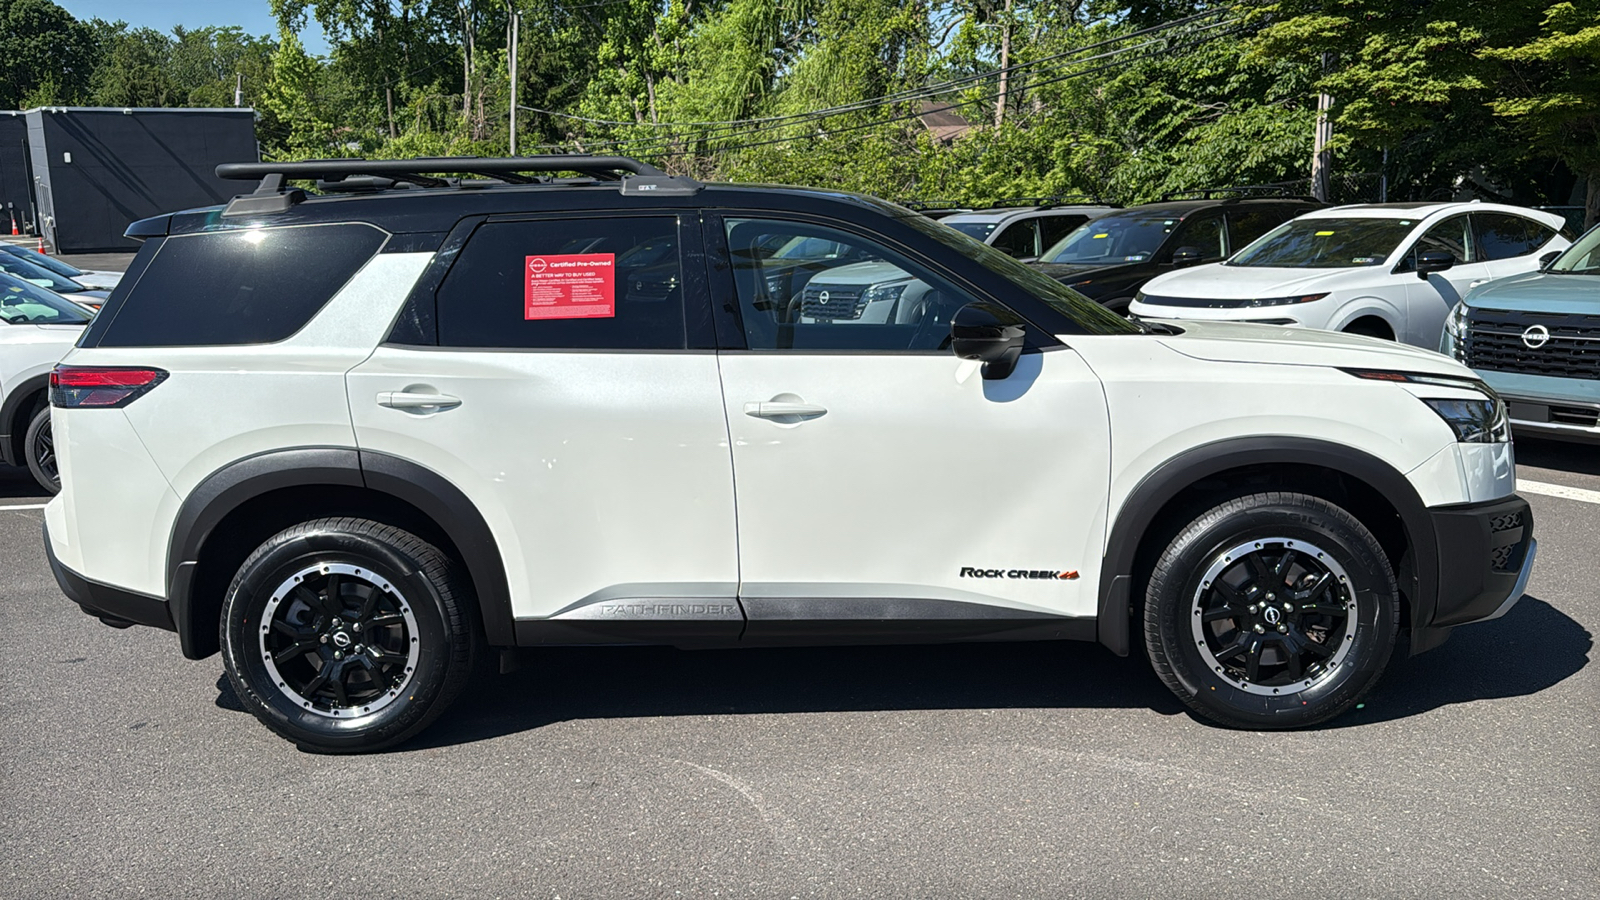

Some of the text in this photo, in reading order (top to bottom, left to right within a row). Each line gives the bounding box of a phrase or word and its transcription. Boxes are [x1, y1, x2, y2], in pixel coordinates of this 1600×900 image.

[960, 566, 1060, 580] ROCK CREEK
[601, 604, 736, 615] PATHFINDER
